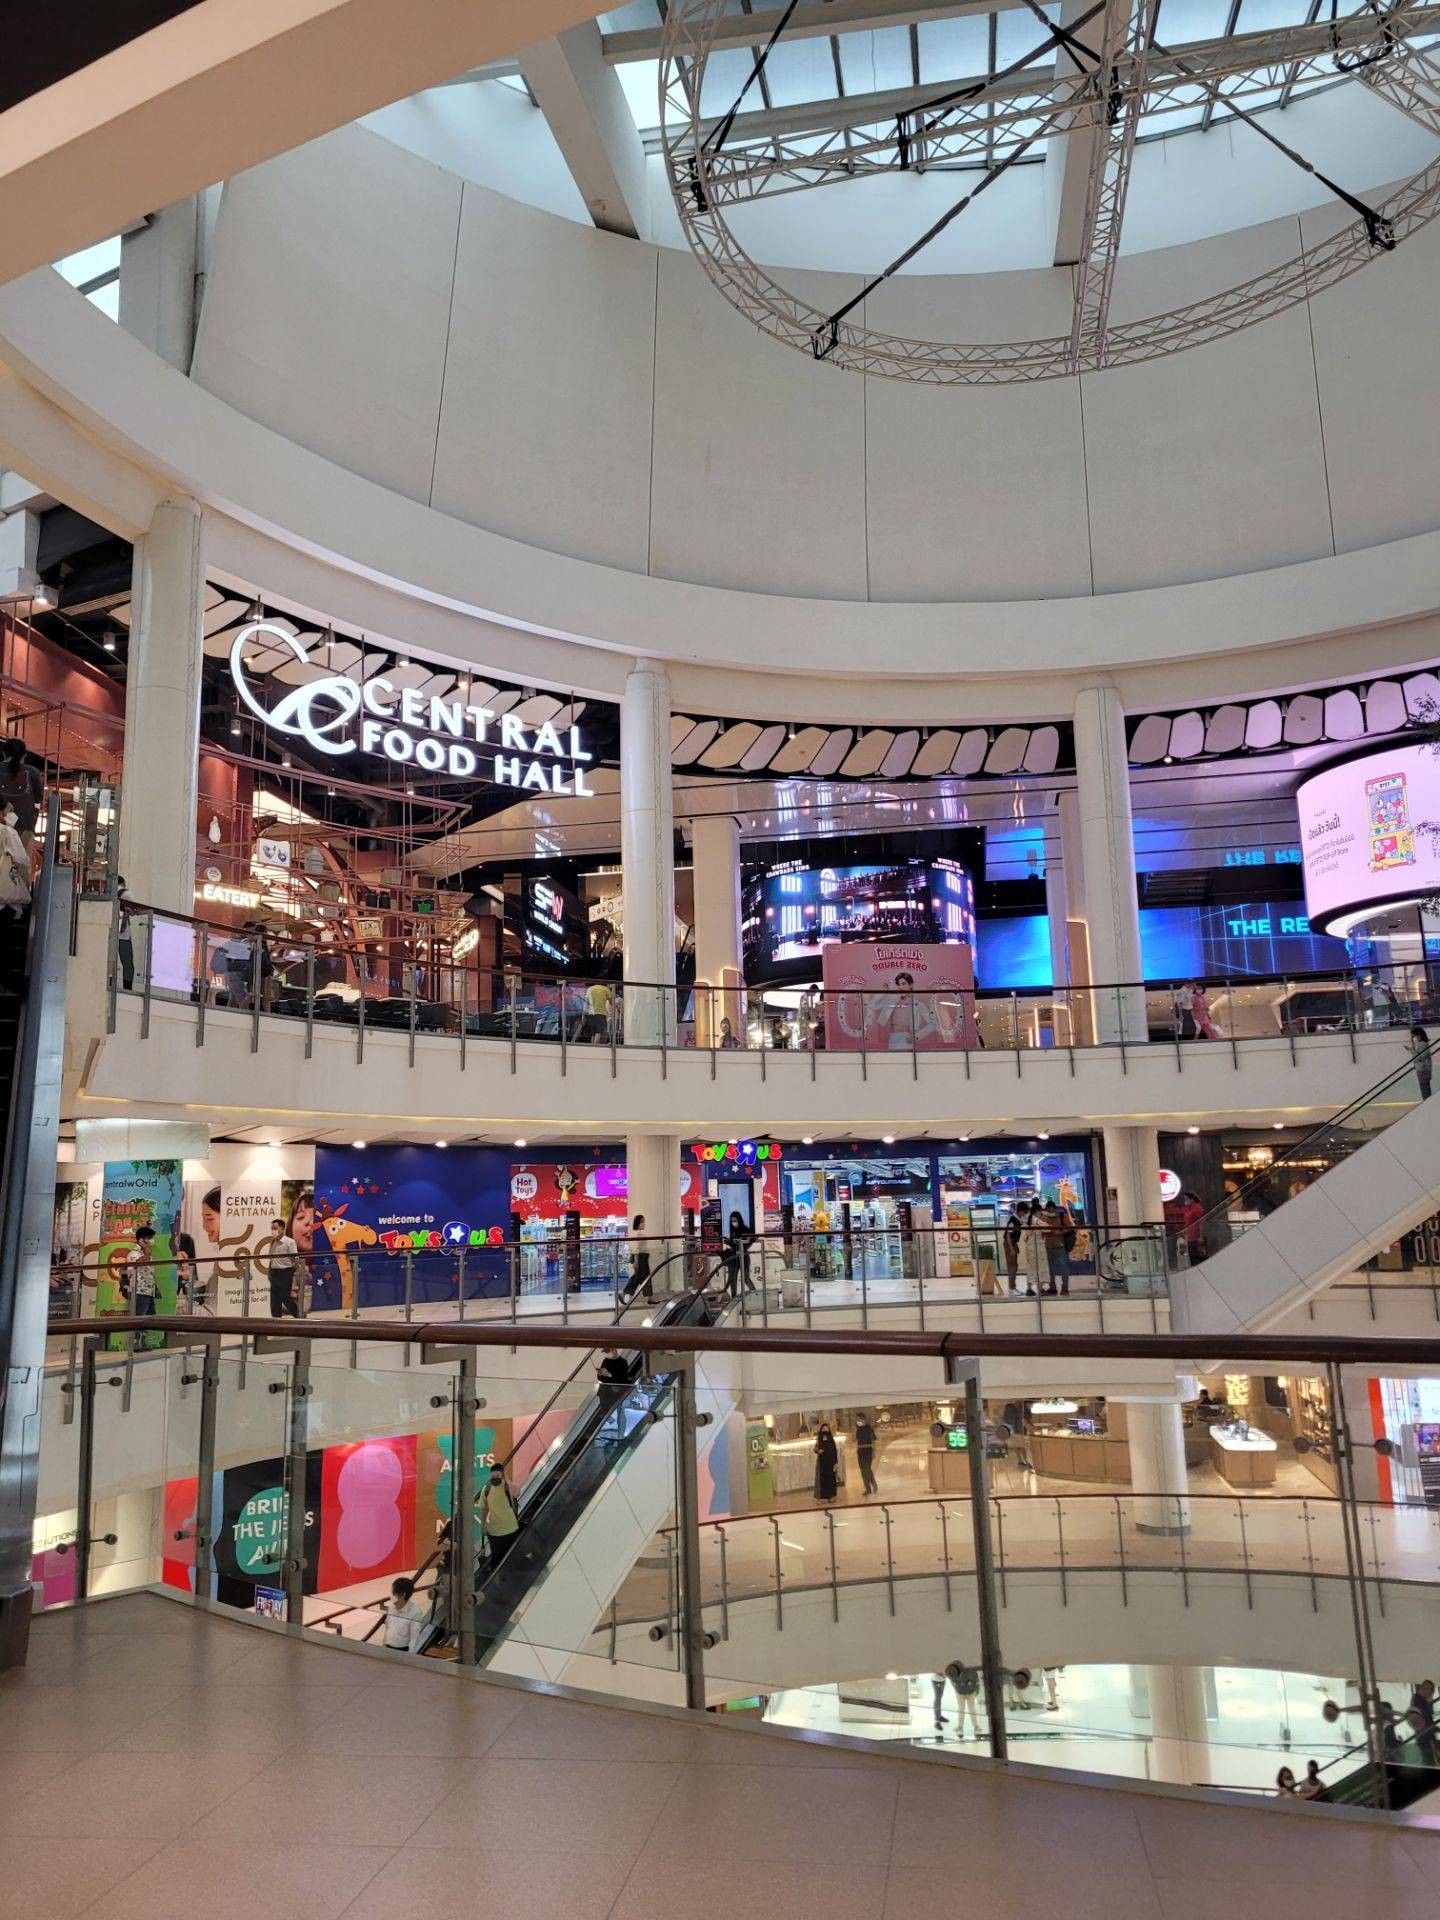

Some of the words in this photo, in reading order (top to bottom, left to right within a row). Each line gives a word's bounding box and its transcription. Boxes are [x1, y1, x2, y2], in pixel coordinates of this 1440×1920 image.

[362, 677, 593, 761] CENTRAL
[362, 720, 476, 776] FOOD
[494, 754, 595, 797] HALL
[203, 884, 261, 909] EATERY
[1227, 917, 1271, 936] THE
[1280, 916, 1309, 934] RE
[872, 961, 904, 972] DOUBLE
[906, 961, 928, 972] ZERO
[104, 1178, 158, 1190] entralwOrld
[516, 1178, 532, 1186] Hot
[515, 1186, 534, 1195] Toys
[226, 1196, 276, 1206] CENTRAL
[226, 1207, 276, 1217] PATTANA
[378, 1214, 420, 1224] welcome
[424, 1213, 434, 1223] to
[224, 1288, 255, 1296] Imagig
[256, 1286, 270, 1294] bett
[949, 1432, 968, 1447] 5G
[232, 1520, 265, 1541] THE
